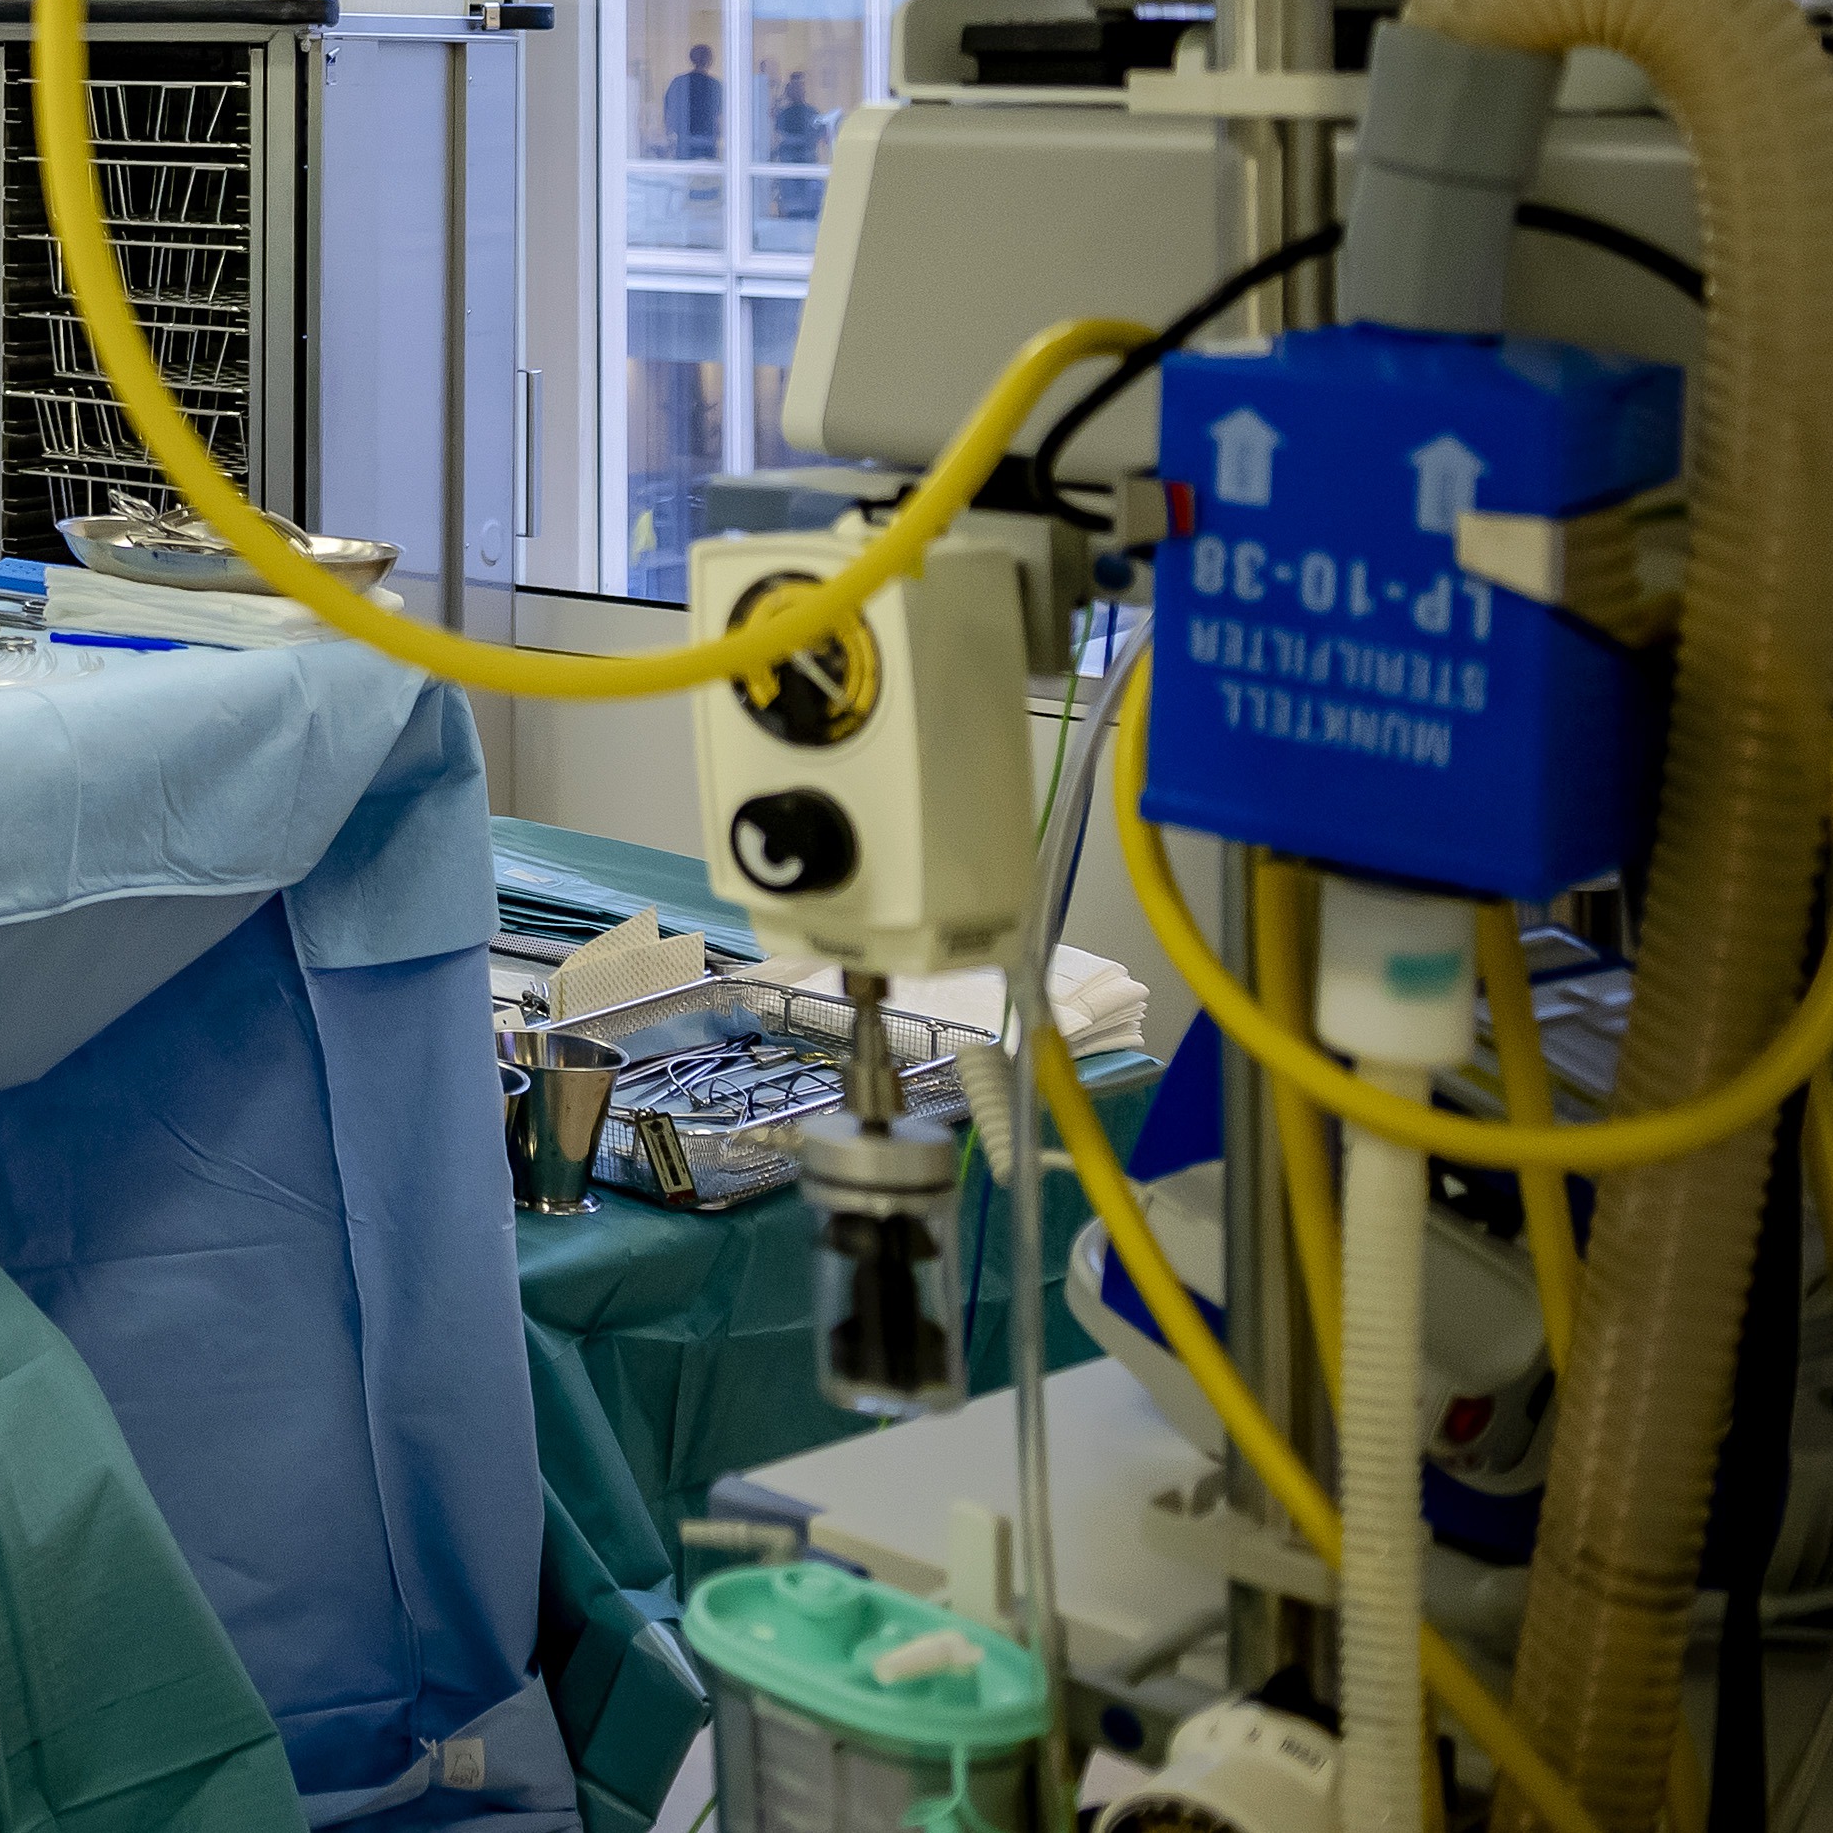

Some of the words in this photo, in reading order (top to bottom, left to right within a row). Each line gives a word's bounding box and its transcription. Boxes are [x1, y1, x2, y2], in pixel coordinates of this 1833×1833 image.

[1192, 536, 1493, 642] LP-10-38
[1188, 618, 1487, 713] STERILFILTER
[1219, 679, 1452, 767] MUNKTELL
